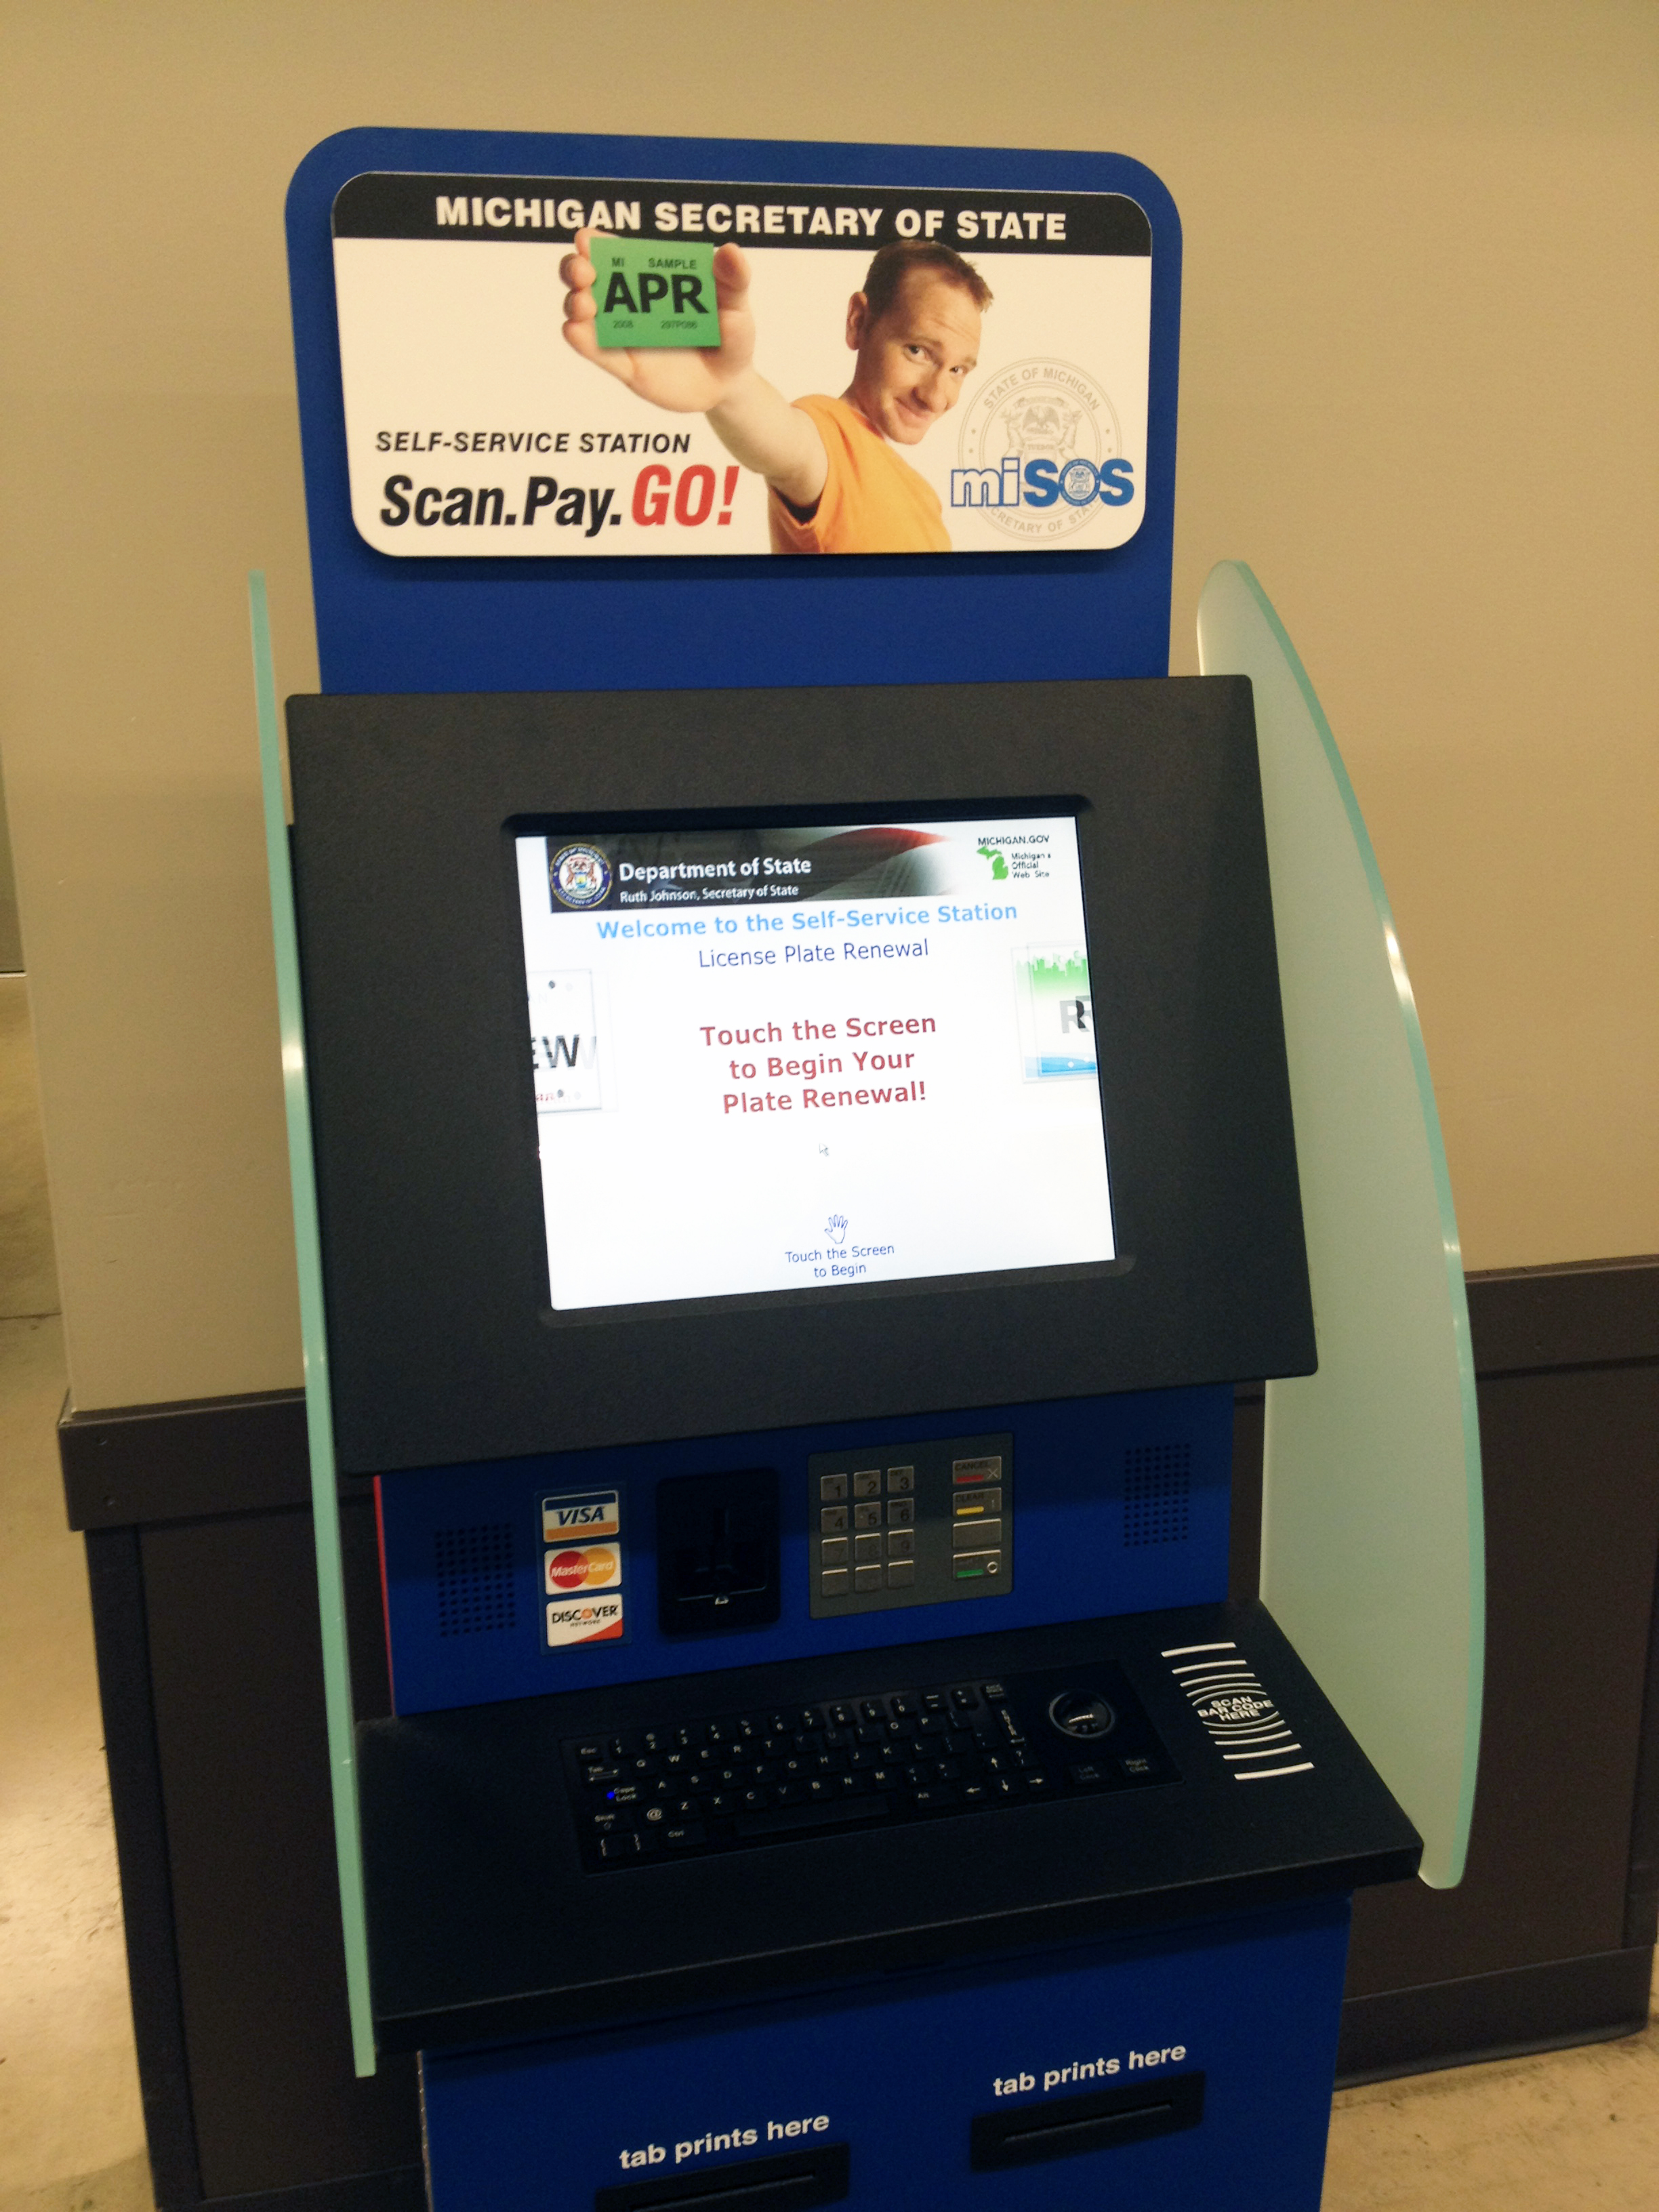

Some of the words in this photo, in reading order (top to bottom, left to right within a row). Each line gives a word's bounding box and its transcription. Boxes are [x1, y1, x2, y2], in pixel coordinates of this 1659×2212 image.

[435, 195, 642, 231] MICHIGAN
[655, 201, 883, 237] SECRETARY
[895, 207, 944, 238] OF
[956, 209, 1067, 241] STATE
[611, 257, 625, 268] MI
[648, 258, 697, 270] SAMPLE
[603, 272, 710, 314] APR
[983, 374, 1019, 409] STATE
[1021, 367, 1039, 381] OF
[1043, 367, 1101, 411] MICHIGAN
[375, 431, 569, 453] SELF-SERVICE
[578, 433, 691, 454] STATION
[631, 464, 741, 527] GO!
[988, 505, 1044, 534] CRETARY
[1047, 522, 1063, 533] OF
[978, 835, 1049, 846] MICHIGAN.GOV
[619, 860, 737, 884] Department
[740, 857, 760, 877] of
[763, 857, 812, 876] State
[1011, 861, 1039, 869] Official
[1012, 871, 1030, 879] Web
[620, 890, 647, 903] Ruth
[649, 888, 700, 902] Johnson,
[702, 886, 756, 900] Secretary
[756, 884, 769, 897] of
[770, 884, 800, 897] State
[596, 919, 708, 940] Welcome
[714, 916, 739, 935] to
[745, 912, 785, 933] the
[792, 907, 930, 931] Self-Service
[937, 903, 1018, 924] Station
[697, 949, 777, 968] License
[784, 944, 836, 964] Plate
[843, 938, 930, 960] Renewal
[699, 1021, 782, 1046] Touch
[792, 1019, 837, 1040] the
[845, 1017, 937, 1038] Screen
[729, 1059, 756, 1079] to
[767, 1053, 842, 1080] Begin
[851, 1051, 915, 1071] Your
[723, 1092, 792, 1113] Plate
[802, 1080, 926, 1109] Renewal!
[785, 1250, 822, 1263] Touch
[827, 1248, 846, 1260] the
[852, 1245, 895, 1257] Screen
[814, 1267, 827, 1277] to
[832, 1263, 866, 1277] Begin
[834, 1485, 841, 1497] 1
[867, 1480, 877, 1494] 2
[900, 1477, 909, 1490] 3
[557, 1505, 605, 1527] VISA
[834, 1515, 844, 1528] 4
[867, 1511, 878, 1525] 5
[900, 1509, 909, 1521] 6
[550, 1560, 615, 1578] MasterCard
[552, 1604, 618, 1624] DISCOVER
[1197, 1706, 1229, 1718] BAR
[1231, 1699, 1275, 1712] CODE
[1210, 1695, 1252, 1708] SCAN
[1218, 1708, 1261, 1721] HERE
[615, 1793, 638, 1802] Lock
[993, 2072, 1036, 2096] tab
[1044, 2057, 1120, 2091] prints
[1128, 2045, 1187, 2070] here
[619, 2143, 667, 2169] tab
[675, 2128, 759, 2165] prints
[767, 2114, 830, 2142] here
